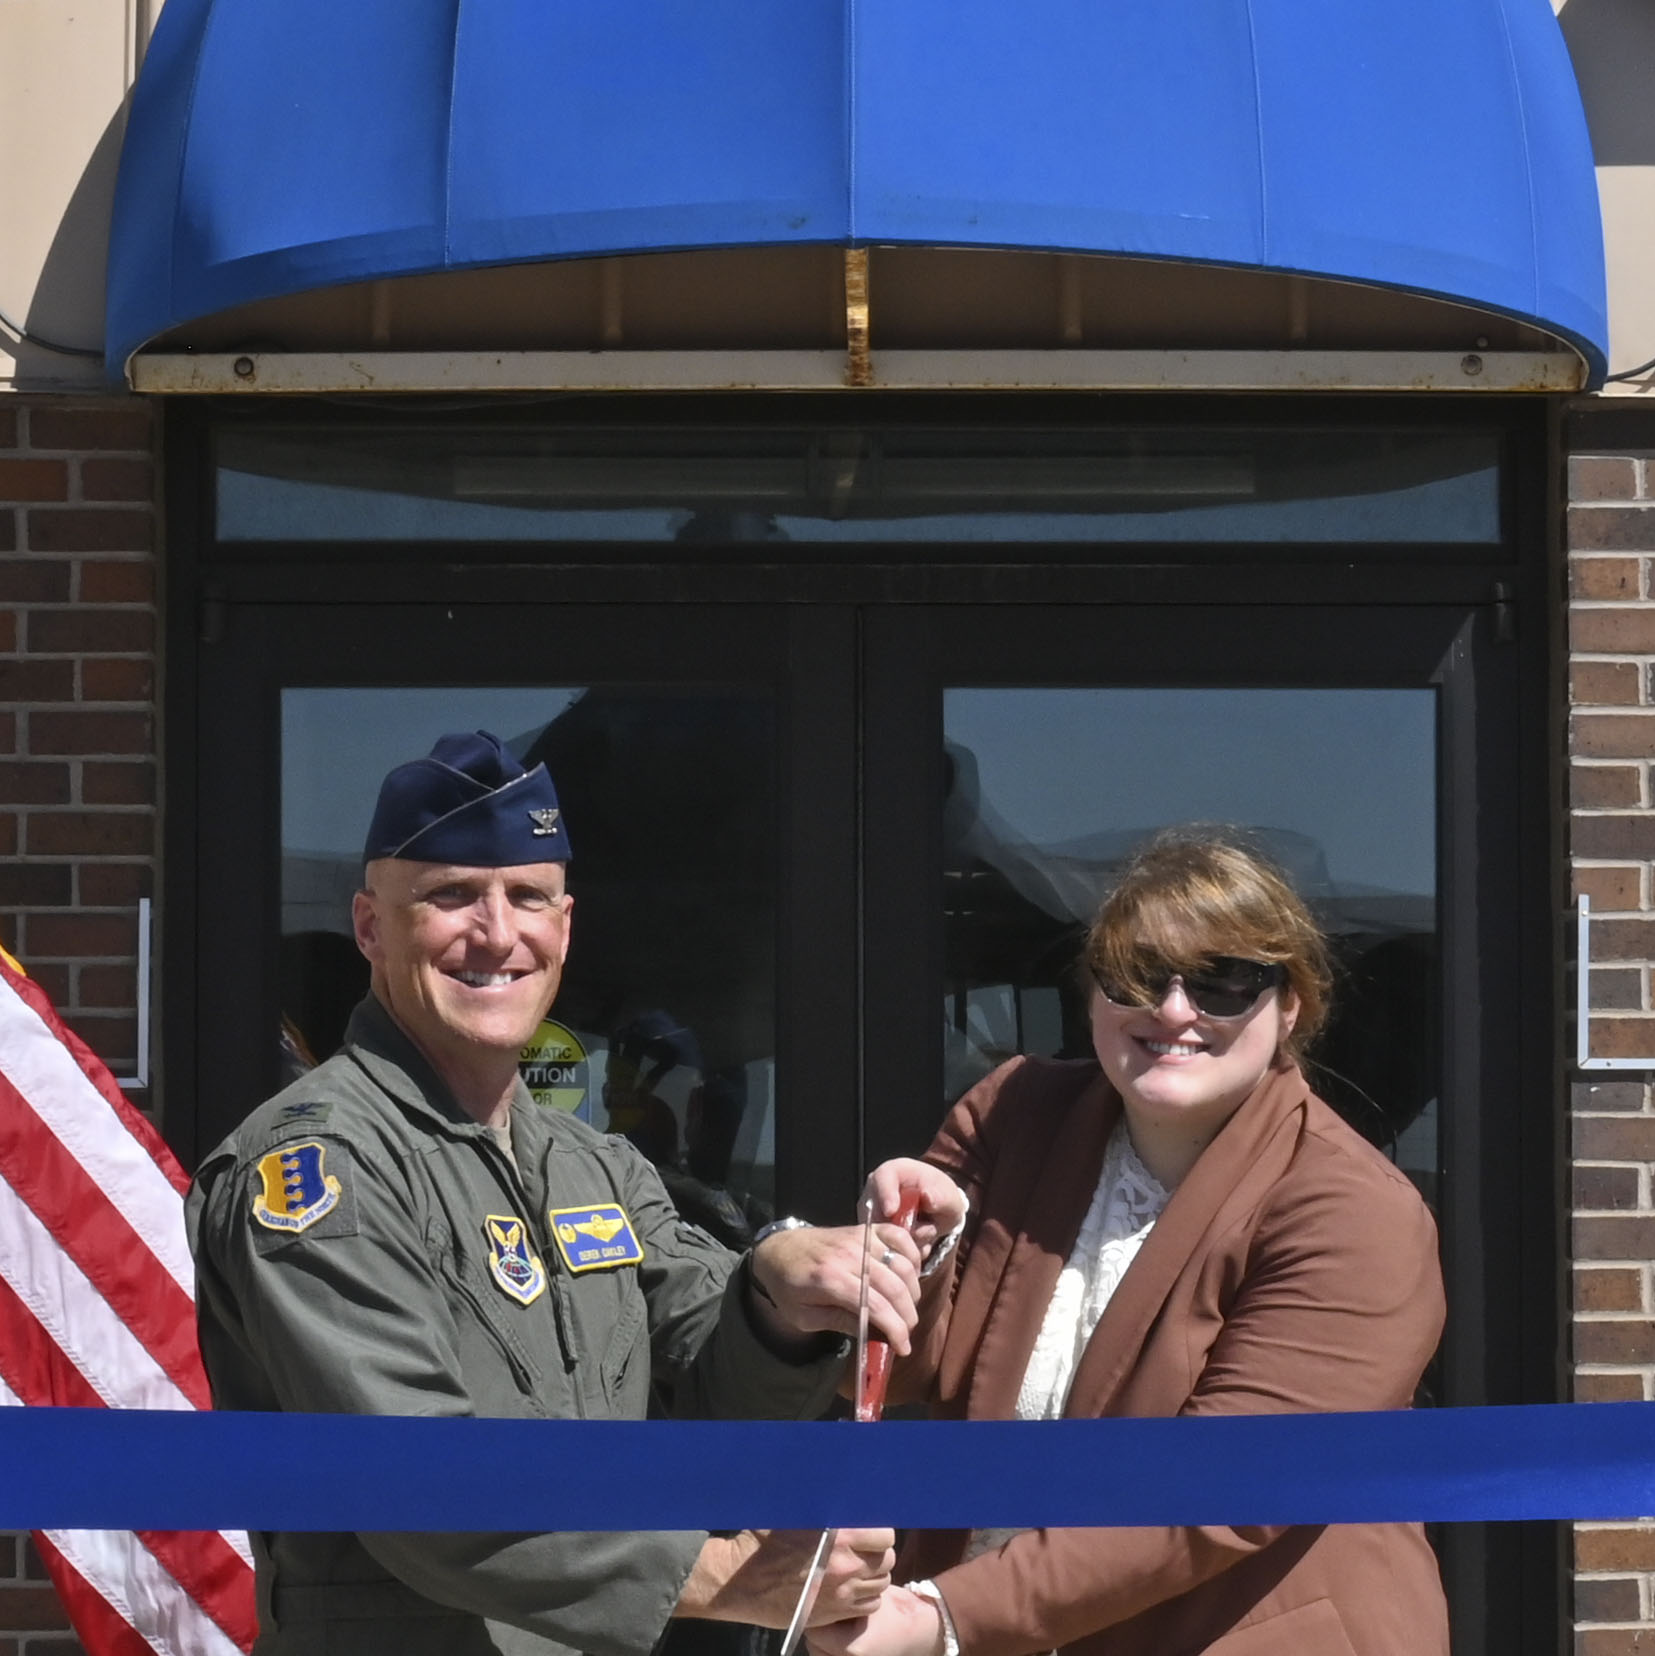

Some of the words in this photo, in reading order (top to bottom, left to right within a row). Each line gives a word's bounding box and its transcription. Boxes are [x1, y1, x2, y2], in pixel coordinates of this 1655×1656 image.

[520, 1047, 572, 1060] OMATIC
[525, 1067, 576, 1083] TION
[533, 1092, 552, 1106] OR
